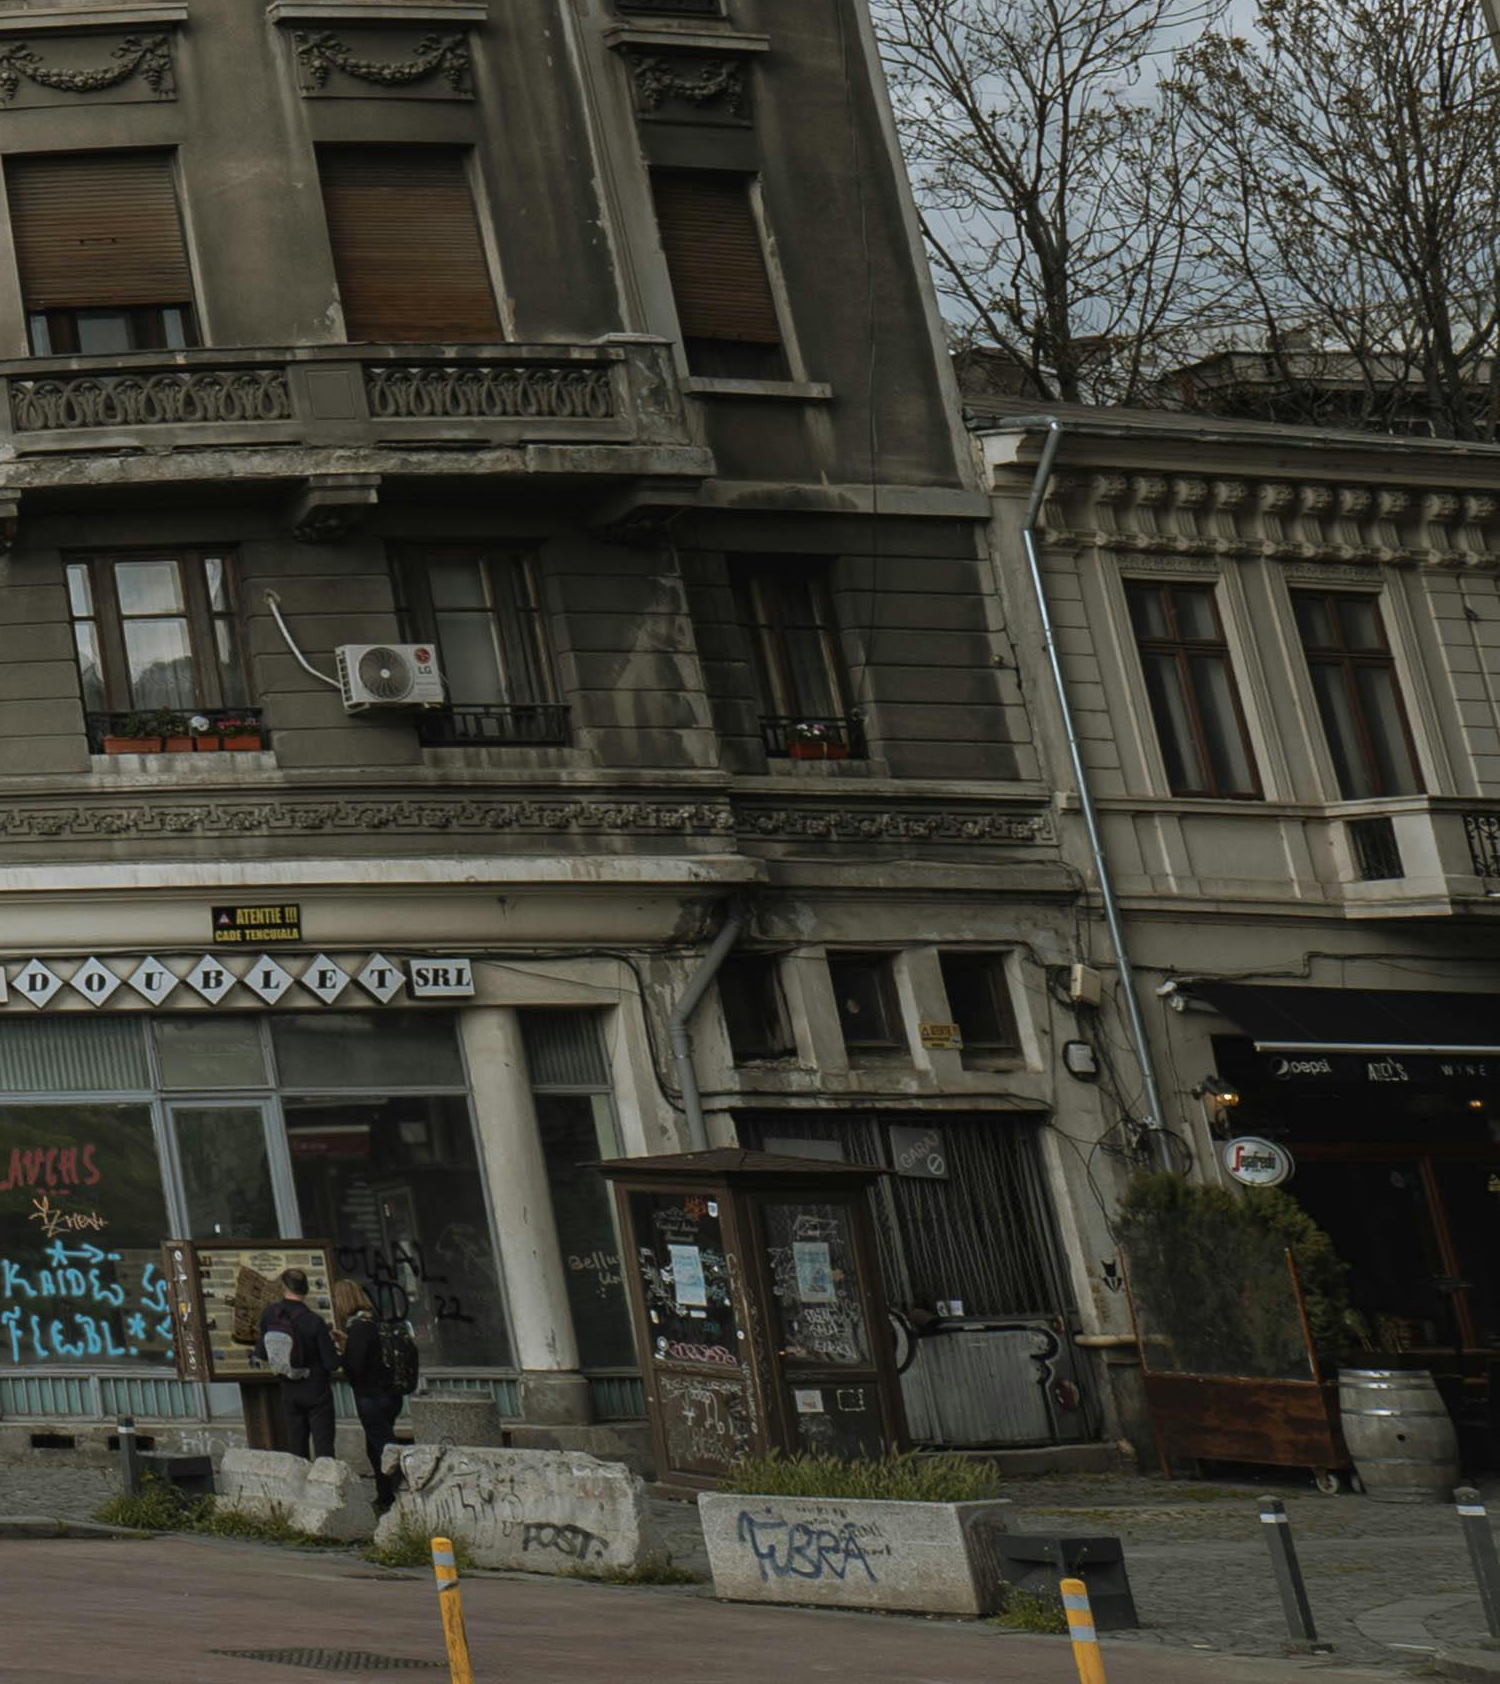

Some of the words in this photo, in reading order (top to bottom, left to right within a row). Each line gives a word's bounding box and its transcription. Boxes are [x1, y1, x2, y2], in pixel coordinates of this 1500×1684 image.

[418, 666, 432, 674] LG
[236, 907, 279, 925] ATENTIE
[215, 930, 240, 942] CADE
[27, 968, 395, 993] DOUBLET
[414, 966, 472, 989] SRL
[1441, 1064, 1487, 1077] WINE
